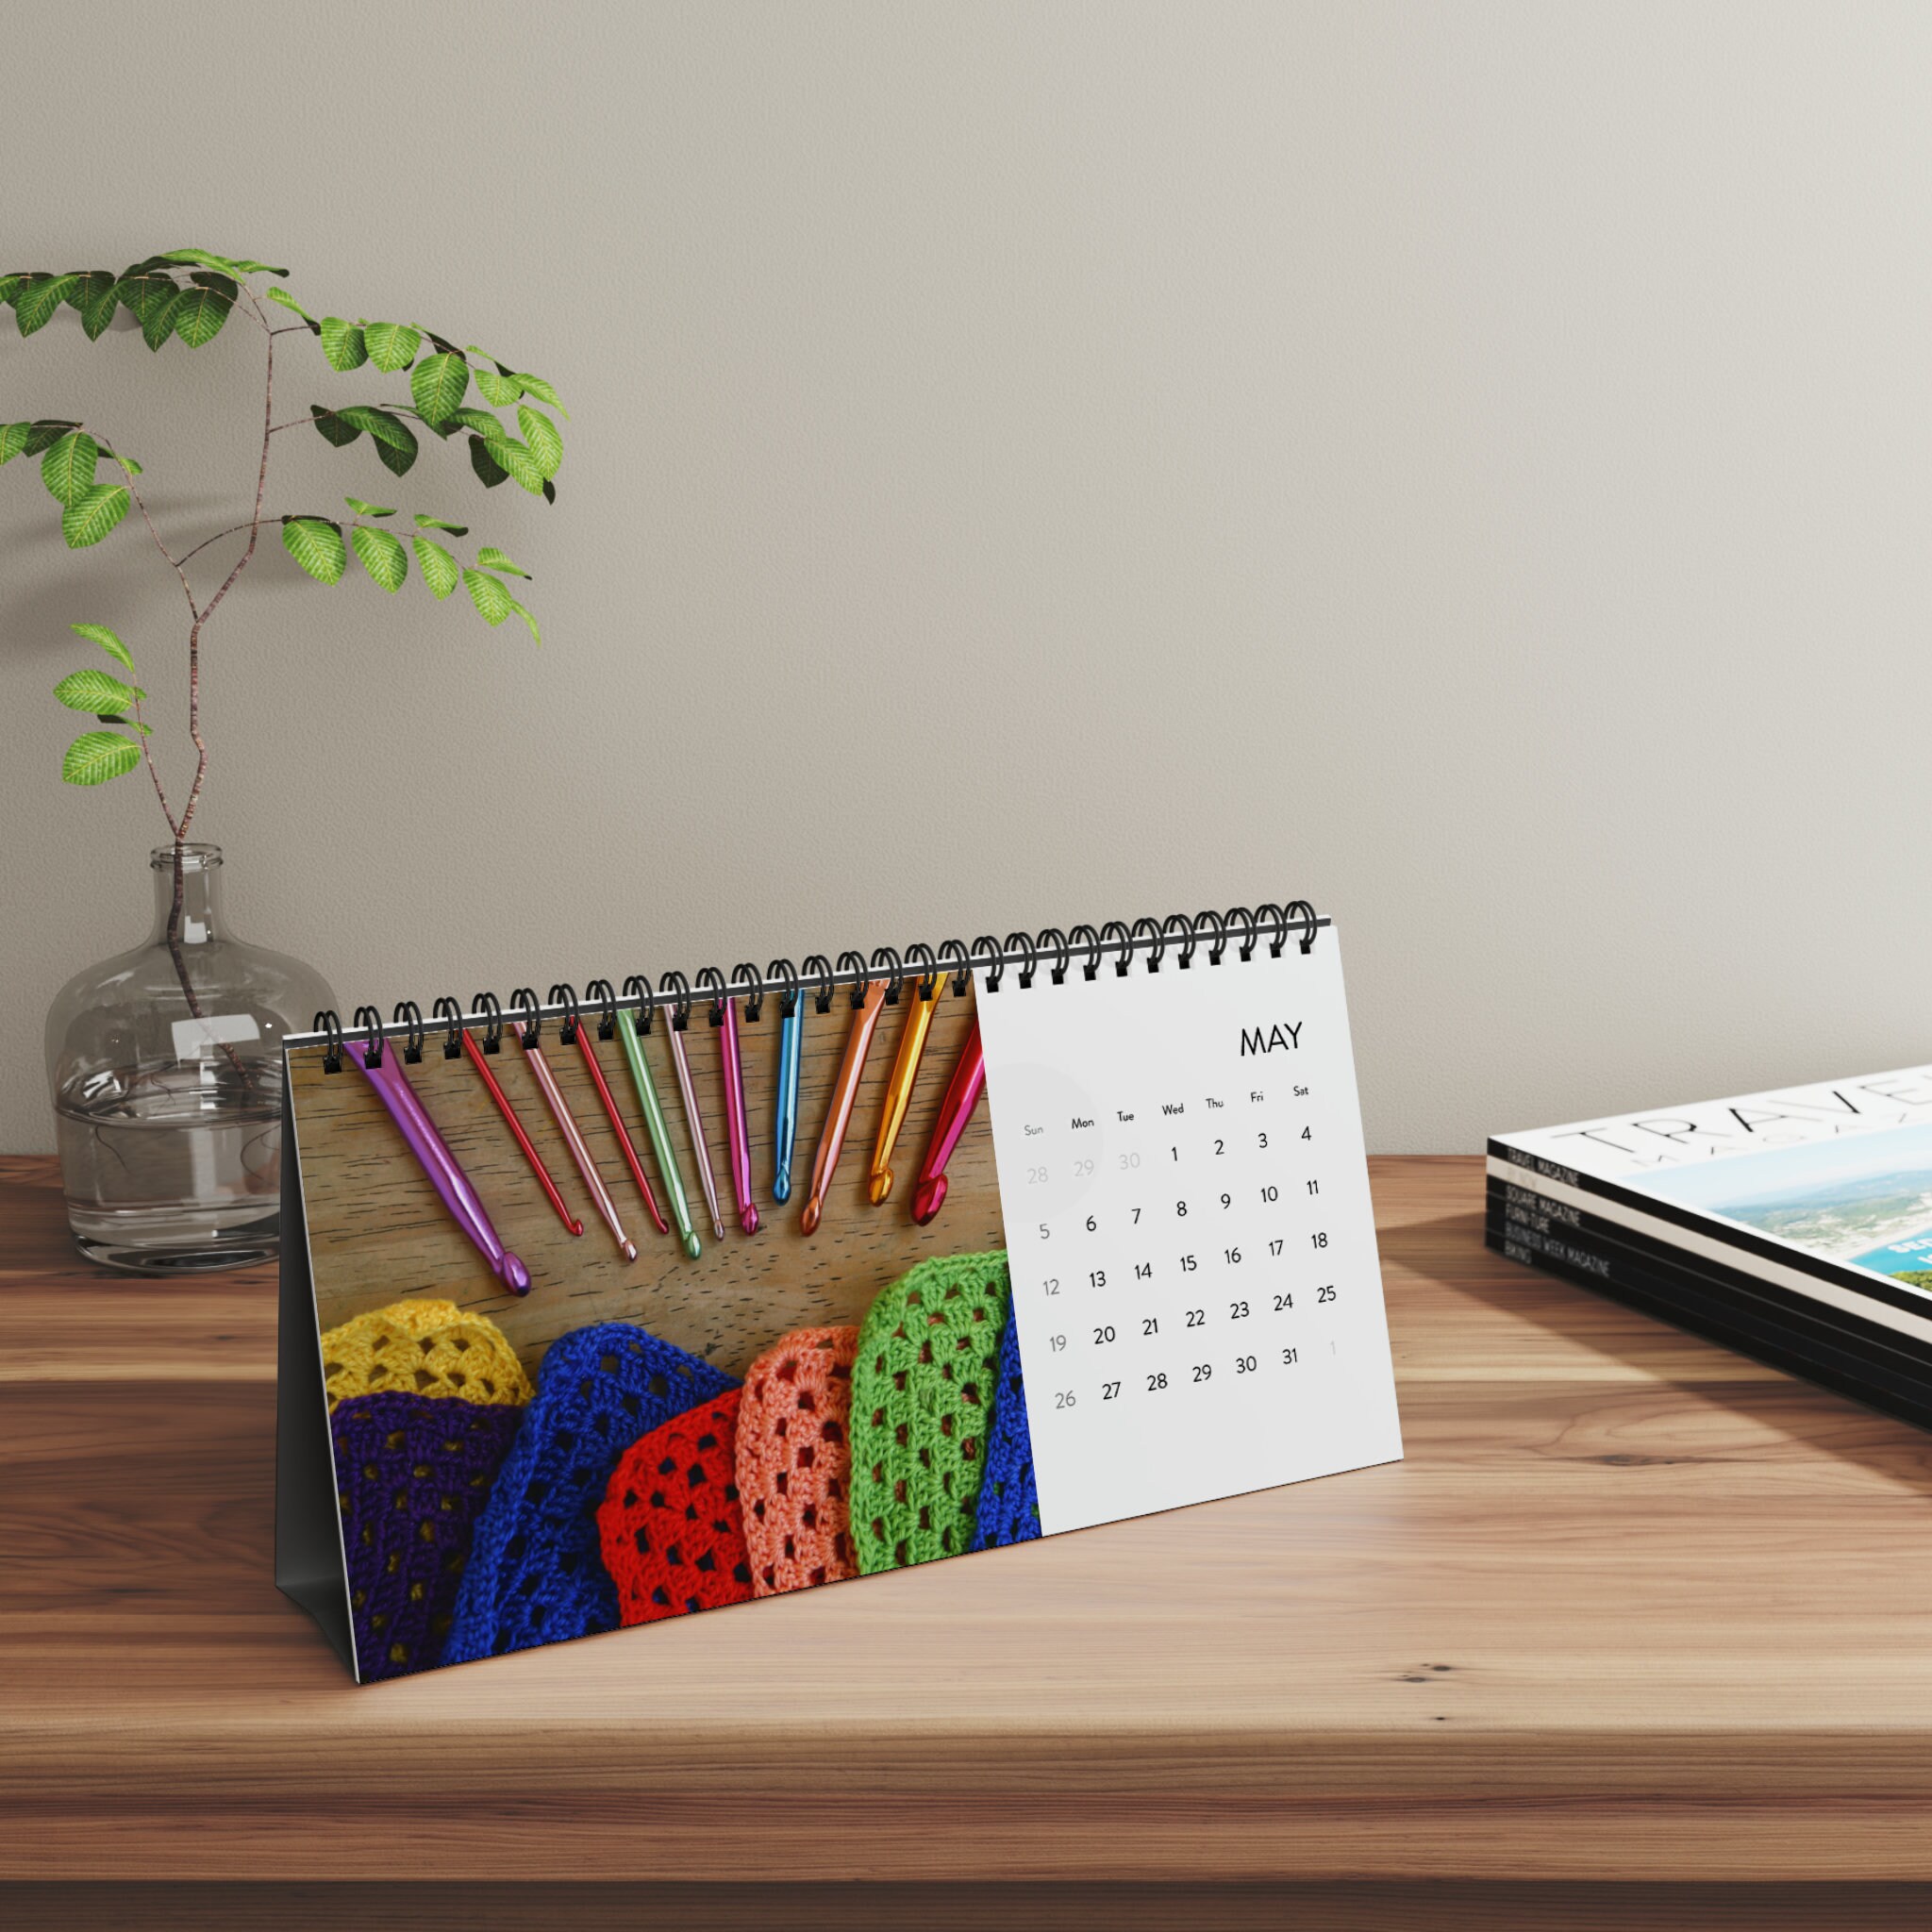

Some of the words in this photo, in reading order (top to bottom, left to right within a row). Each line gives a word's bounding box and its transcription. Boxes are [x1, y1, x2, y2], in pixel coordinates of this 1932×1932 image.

[1240, 1021, 1303, 1057] MAY
[1024, 1124, 1044, 1137] Sun
[1072, 1117, 1094, 1130] Mon
[1116, 1110, 1135, 1124] Tue
[1161, 1103, 1184, 1116] Wed
[1206, 1096, 1224, 1109] Thu
[1250, 1090, 1264, 1104] Fri
[1292, 1085, 1309, 1097] Sat
[1548, 1074, 1932, 1154] TRAVE
[1026, 1167, 1048, 1184] 28
[1074, 1159, 1094, 1176] 29
[1119, 1153, 1140, 1170] 30
[1171, 1146, 1177, 1161] 1
[1213, 1139, 1224, 1155] 2
[1257, 1133, 1268, 1148] 3
[1300, 1125, 1312, 1141] 4
[1508, 1147, 1536, 1172] TRAVEL
[1537, 1158, 1579, 1188] MAGAZINE
[1039, 1224, 1050, 1240] 5
[1086, 1215, 1098, 1232] 6
[1130, 1208, 1142, 1224] 7
[1175, 1200, 1189, 1217] 8
[1220, 1192, 1231, 1209] 9
[1260, 1186, 1279, 1204] 10
[1307, 1178, 1320, 1195] 11
[1507, 1185, 1537, 1209] SQUARE
[1539, 1195, 1581, 1226] MAGAZINE
[1042, 1278, 1060, 1296] 12
[1088, 1270, 1108, 1289] 13
[1133, 1262, 1154, 1280] 14
[1179, 1255, 1198, 1273] 15
[1224, 1247, 1242, 1265] 16
[1268, 1239, 1285, 1257] 17
[1310, 1231, 1329, 1249] 18
[1506, 1223, 1541, 1252] BUSINESS
[1543, 1237, 1566, 1259] WEEK
[1567, 1247, 1610, 1277] MAGAZINE
[1049, 1334, 1067, 1353] 19
[1092, 1324, 1117, 1345] 20
[1141, 1317, 1159, 1335] 21
[1185, 1308, 1207, 1328] 22
[1229, 1301, 1251, 1320] 23
[1273, 1292, 1294, 1312] 24
[1316, 1285, 1338, 1304] 25
[1054, 1390, 1077, 1409] 26
[1101, 1381, 1122, 1400] 27
[1145, 1373, 1169, 1391] 28
[1191, 1363, 1213, 1383] 29
[1235, 1355, 1258, 1374] 30
[1281, 1347, 1299, 1365] 31
